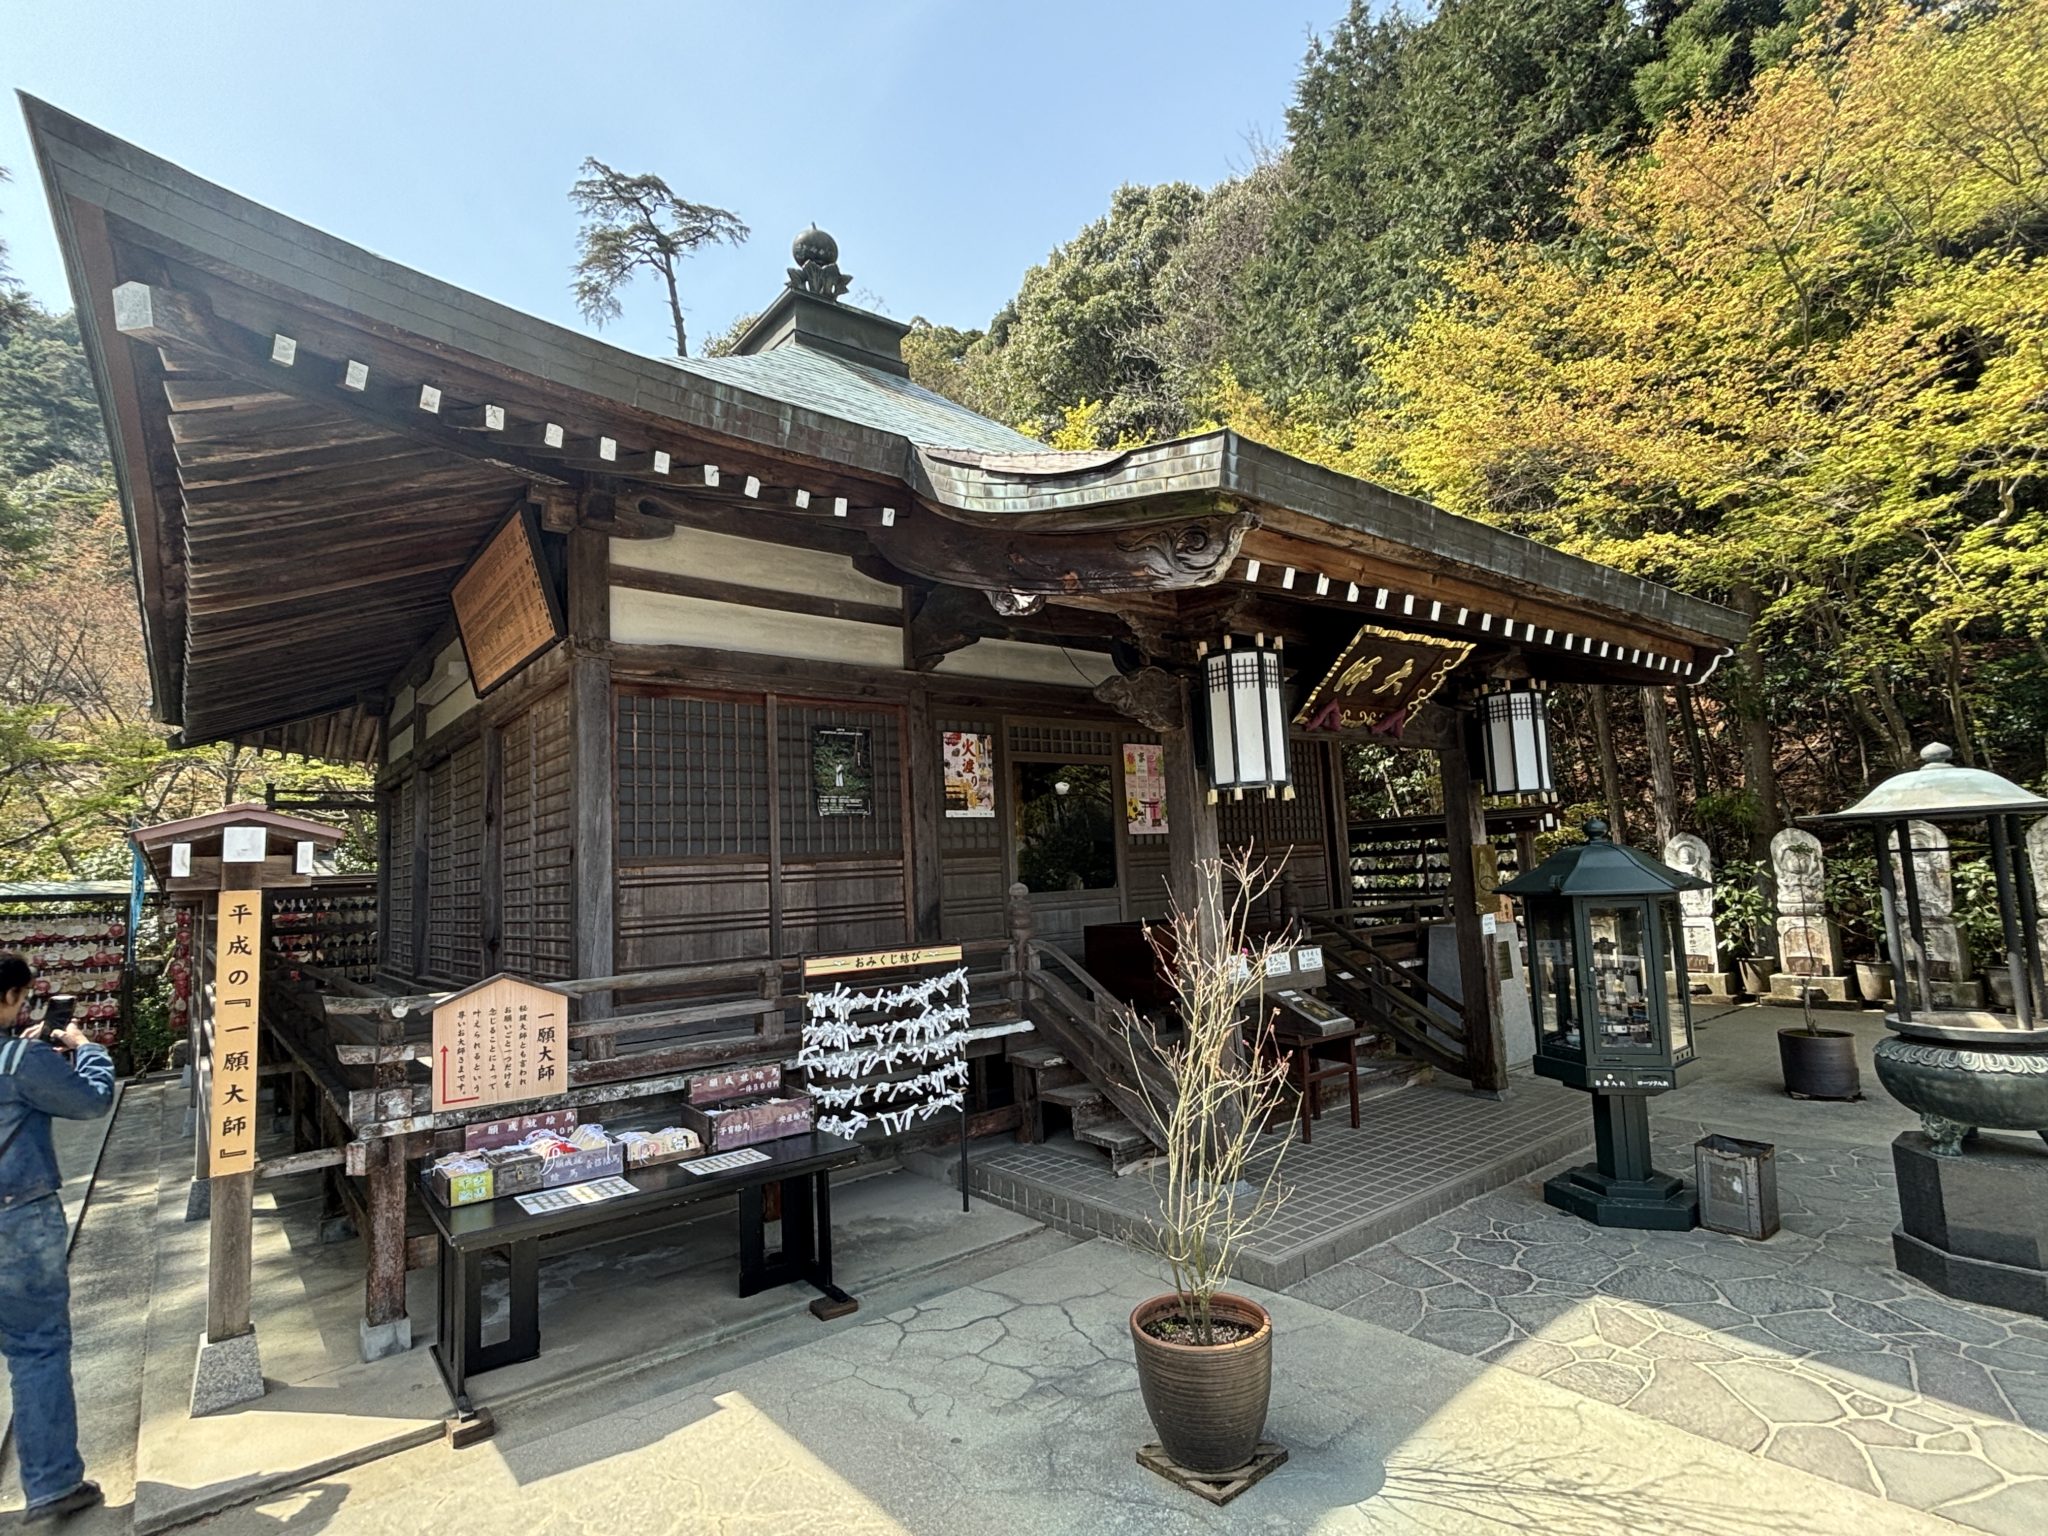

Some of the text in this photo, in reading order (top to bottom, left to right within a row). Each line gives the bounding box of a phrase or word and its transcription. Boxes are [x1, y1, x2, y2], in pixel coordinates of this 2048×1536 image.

[855, 951, 921, 968] おみくじ結び
[219, 904, 253, 1159] 平成の『一願大師』
[457, 1010, 466, 1095] 尊いお大師さまです。
[472, 1009, 481, 1093] 叶えられるという
[488, 1007, 497, 1090] 念じることによって
[503, 1006, 513, 1088] お願いごと一つだけを
[519, 1005, 528, 1085] 秘鍵大師とも言われ
[537, 1012, 556, 1081] 一願大師
[693, 1067, 779, 1088] 一願成就絵馬
[468, 1111, 576, 1136] 一願成就絵馬
